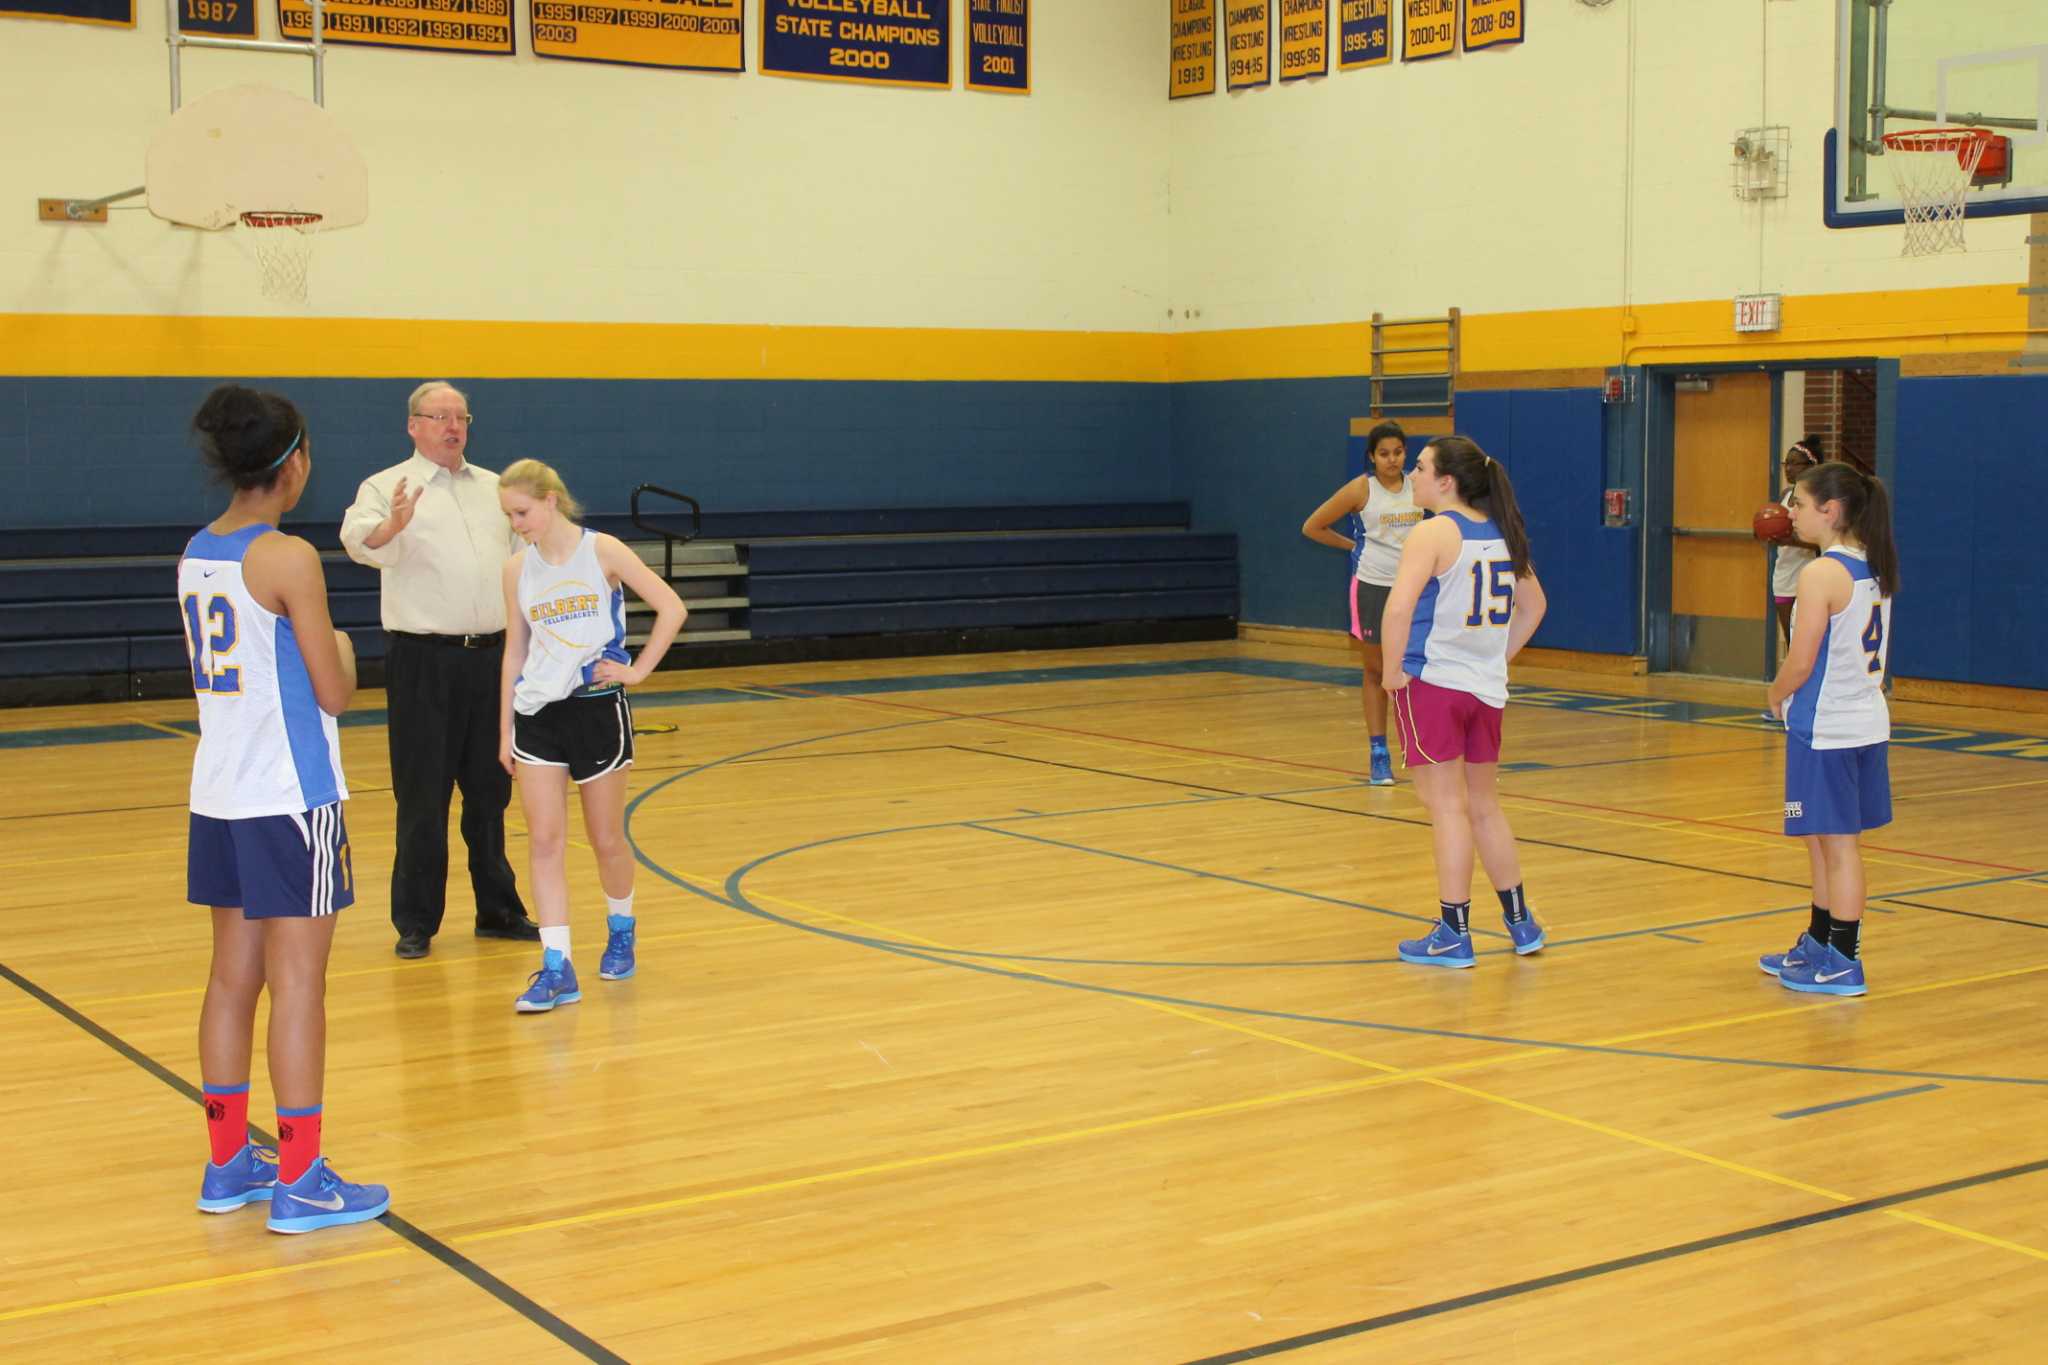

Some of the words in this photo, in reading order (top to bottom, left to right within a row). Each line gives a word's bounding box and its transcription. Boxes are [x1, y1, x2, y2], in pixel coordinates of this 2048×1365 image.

[188, 0, 240, 22] 1987
[538, 4, 574, 21] 1995
[581, 6, 616, 24] 1997
[623, 10, 657, 28] 1999
[663, 14, 697, 32] 2000
[703, 18, 738, 34] 2001
[1471, 10, 1516, 36] 2008-09
[287, 11, 325, 29] 199
[334, 14, 371, 33] 1991
[380, 18, 419, 35] 1992
[426, 21, 463, 39] 1993
[469, 25, 506, 42] 1994
[537, 25, 575, 42] 2003
[775, 15, 833, 38] STATE
[839, 21, 941, 46] CHAMPIONS
[973, 23, 1024, 47] VOLLEYBALL
[1410, 22, 1451, 46] 2000-01
[1344, 28, 1384, 52] 1995-96
[829, 48, 890, 69] 2000
[983, 55, 1016, 75] 2001
[1740, 300, 1766, 326] EXIT
[1464, 559, 1518, 629] 15
[528, 594, 600, 622] GILBERT
[183, 590, 244, 696] 12
[1859, 601, 1886, 675] 4
